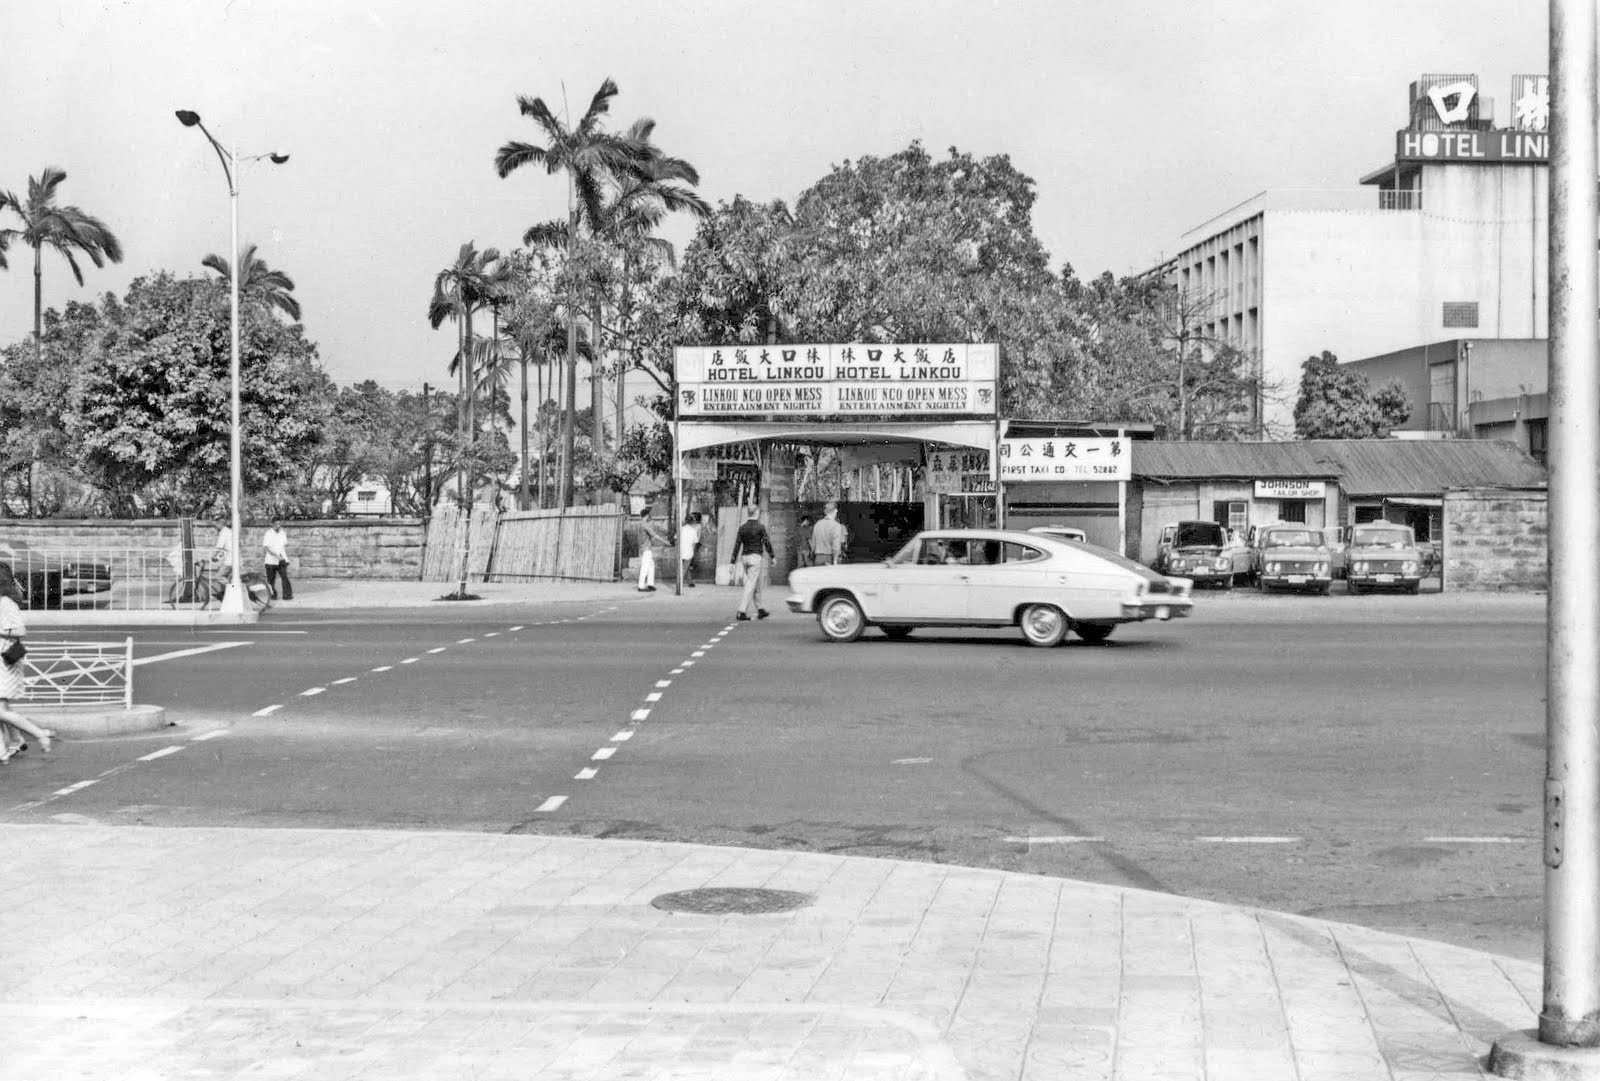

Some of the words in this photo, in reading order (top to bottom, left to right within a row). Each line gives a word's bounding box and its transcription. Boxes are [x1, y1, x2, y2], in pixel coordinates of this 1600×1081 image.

[1404, 133, 1485, 157] HOTEL
[1501, 134, 1549, 158] LIN
[708, 367, 758, 380] HOTEL
[766, 366, 825, 380] LINKOU
[836, 366, 891, 379] HOTEL
[899, 366, 961, 379] LINKOU
[702, 387, 739, 402] LINKOU
[743, 387, 762, 402] NCO
[766, 387, 792, 402] OPEN
[795, 387, 823, 401] MESS
[838, 387, 878, 401] LINKOU
[882, 387, 903, 401] NCO
[907, 387, 935, 401] OPEN
[938, 387, 968, 401] MESS
[703, 402, 780, 411] ENTERTAINMENT
[783, 401, 822, 410] NIGHTLY
[839, 401, 922, 410] ENTERTAINMENT
[925, 401, 967, 410] NIGHTLY
[1002, 465, 1026, 475] FIRST
[1030, 465, 1049, 474] TAXI
[1261, 480, 1310, 489] JOHNSON
